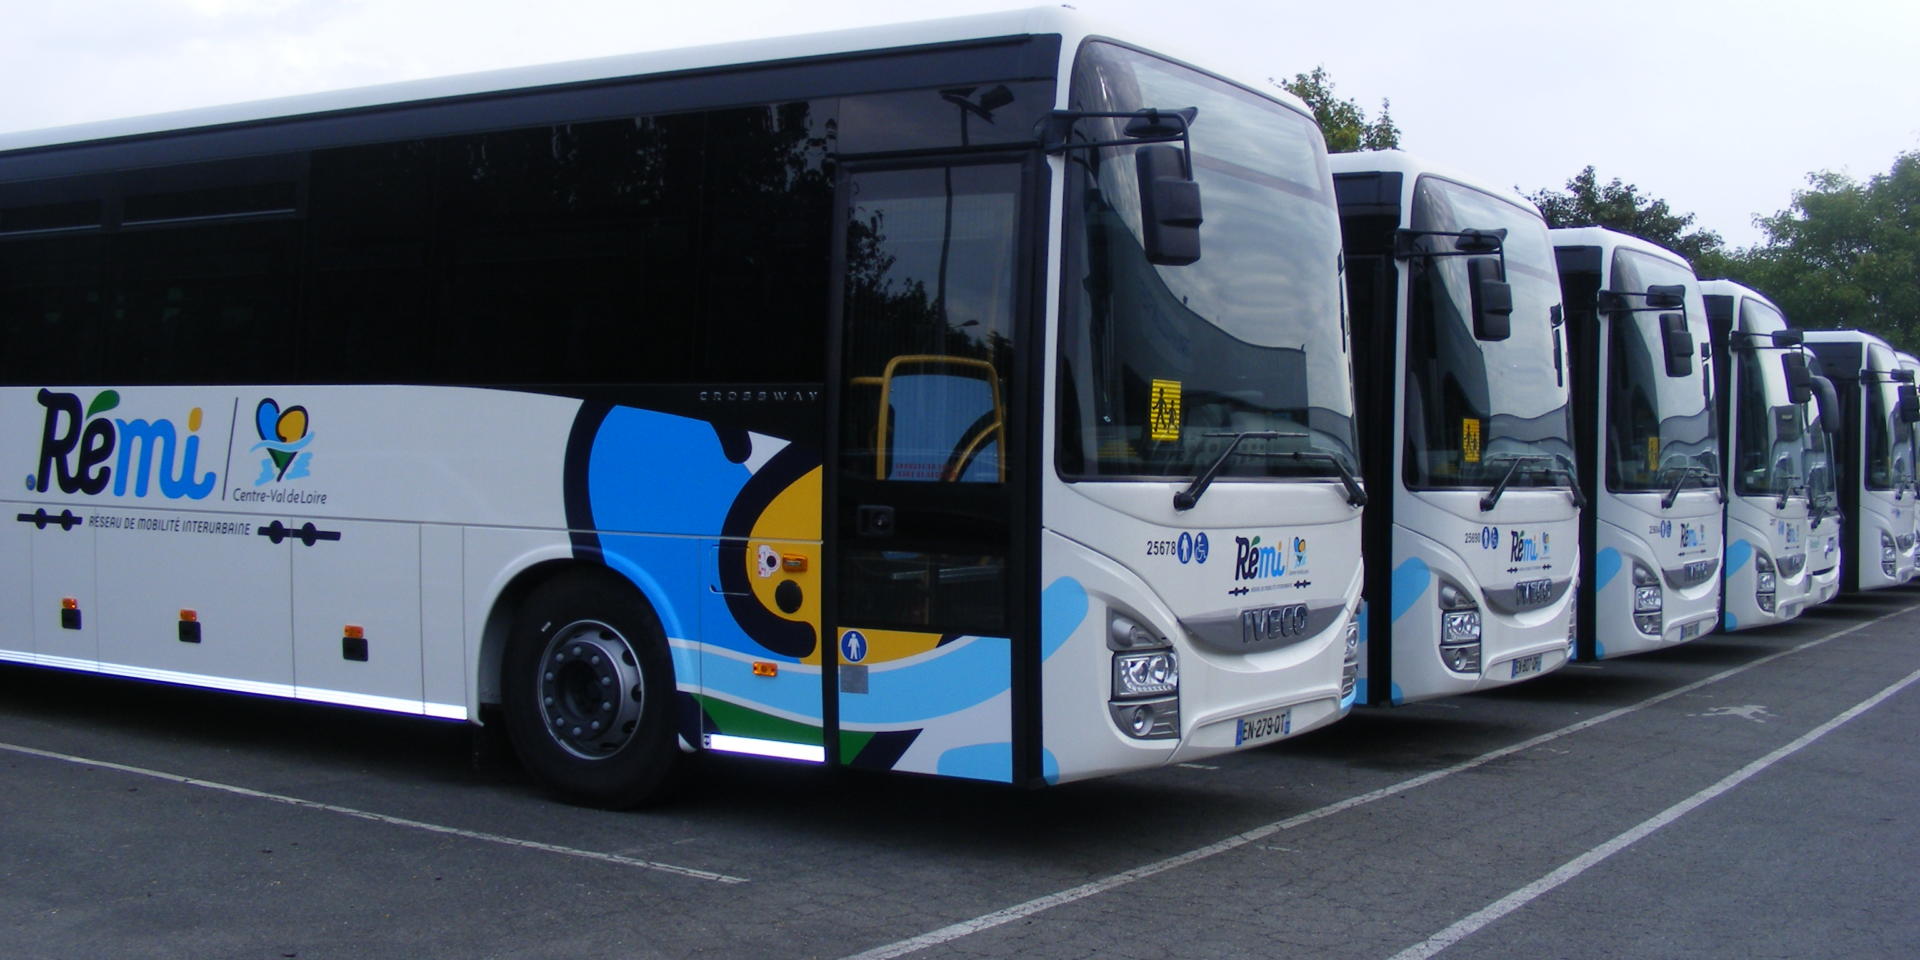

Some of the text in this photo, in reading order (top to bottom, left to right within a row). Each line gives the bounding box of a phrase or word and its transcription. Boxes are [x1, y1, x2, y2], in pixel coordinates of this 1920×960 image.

[700, 391, 818, 401] CROSSWAY
[37, 388, 216, 500] Rémi
[233, 488, 327, 504] Centre-Val de Loire
[89, 514, 251, 536] RÉSEAU DE MOBILITÉ INTERURBAINE
[1147, 540, 1176, 555] 25678
[1235, 535, 1285, 581] Rémi
[1511, 530, 1537, 562] Rémi
[1243, 604, 1307, 643] IVECO
